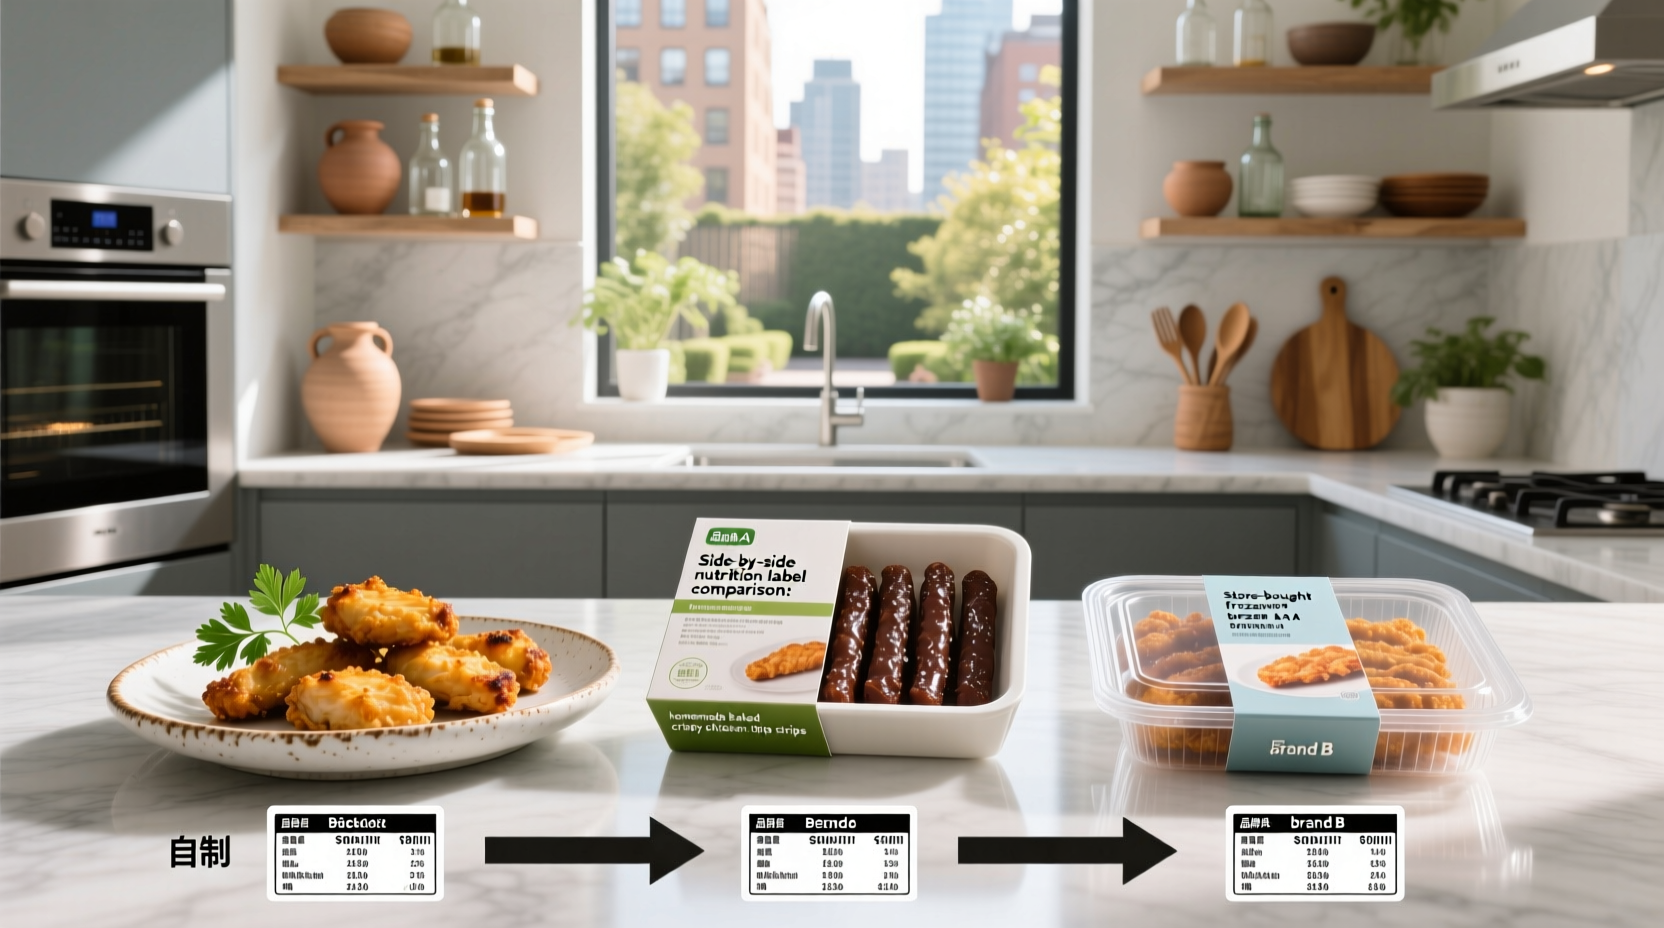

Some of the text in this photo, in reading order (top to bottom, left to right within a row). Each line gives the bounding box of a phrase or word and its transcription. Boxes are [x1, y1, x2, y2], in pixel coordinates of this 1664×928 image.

[694, 568, 807, 582] nutrition label
[691, 583, 792, 599] comparison:
